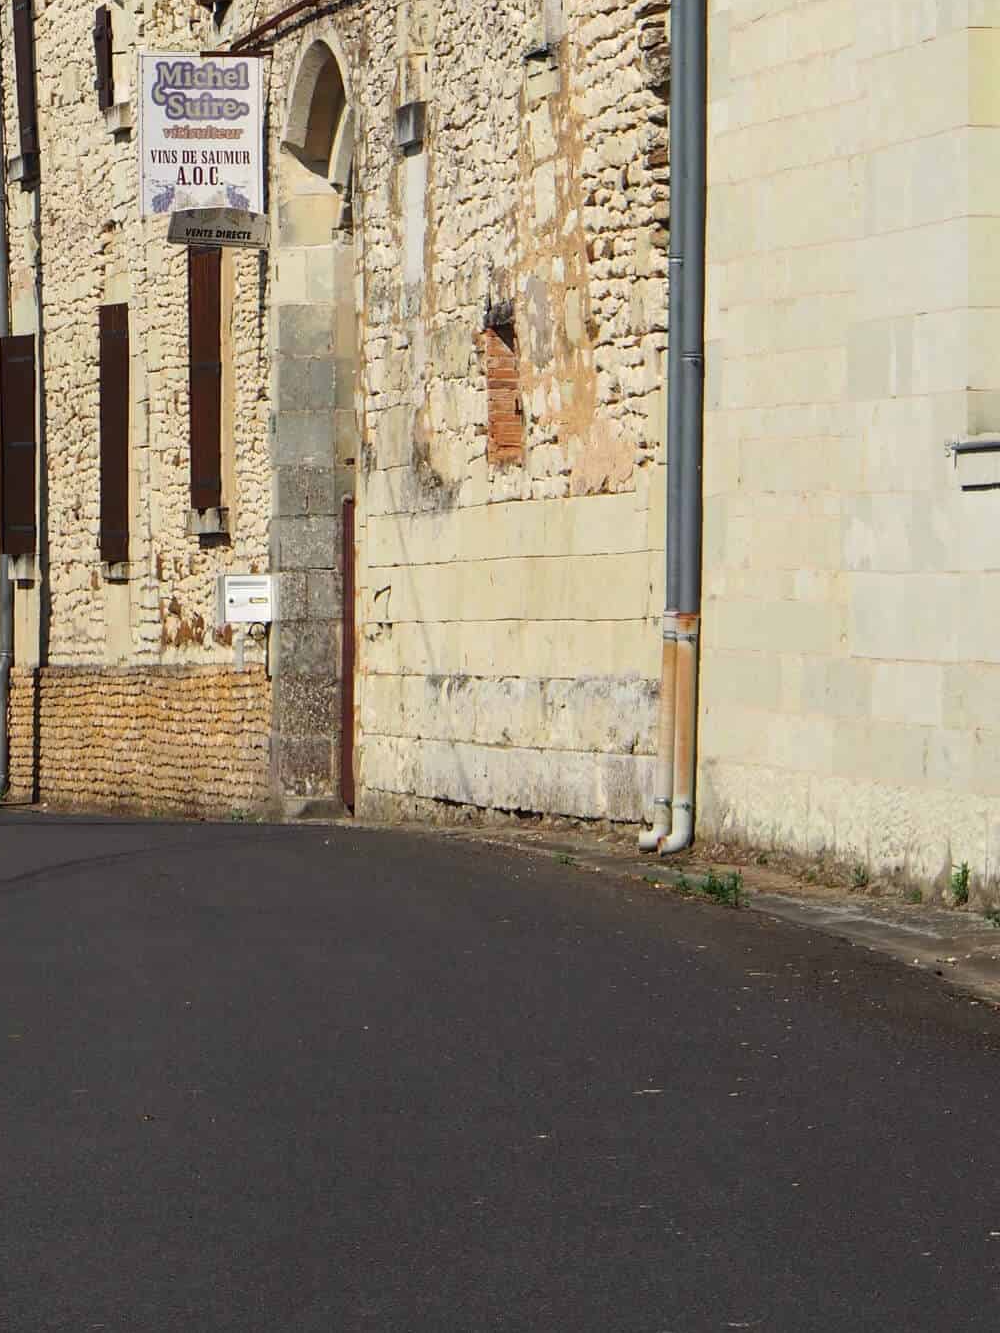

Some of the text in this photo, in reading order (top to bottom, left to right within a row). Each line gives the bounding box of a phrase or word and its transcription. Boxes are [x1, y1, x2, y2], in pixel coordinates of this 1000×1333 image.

[156, 62, 249, 90] Michel
[164, 92, 246, 120] Suire
[151, 149, 251, 165] VINS DE SAUMUR
[176, 166, 224, 186] A.O.C.
[185, 227, 252, 240] VENTE DIRECTE
